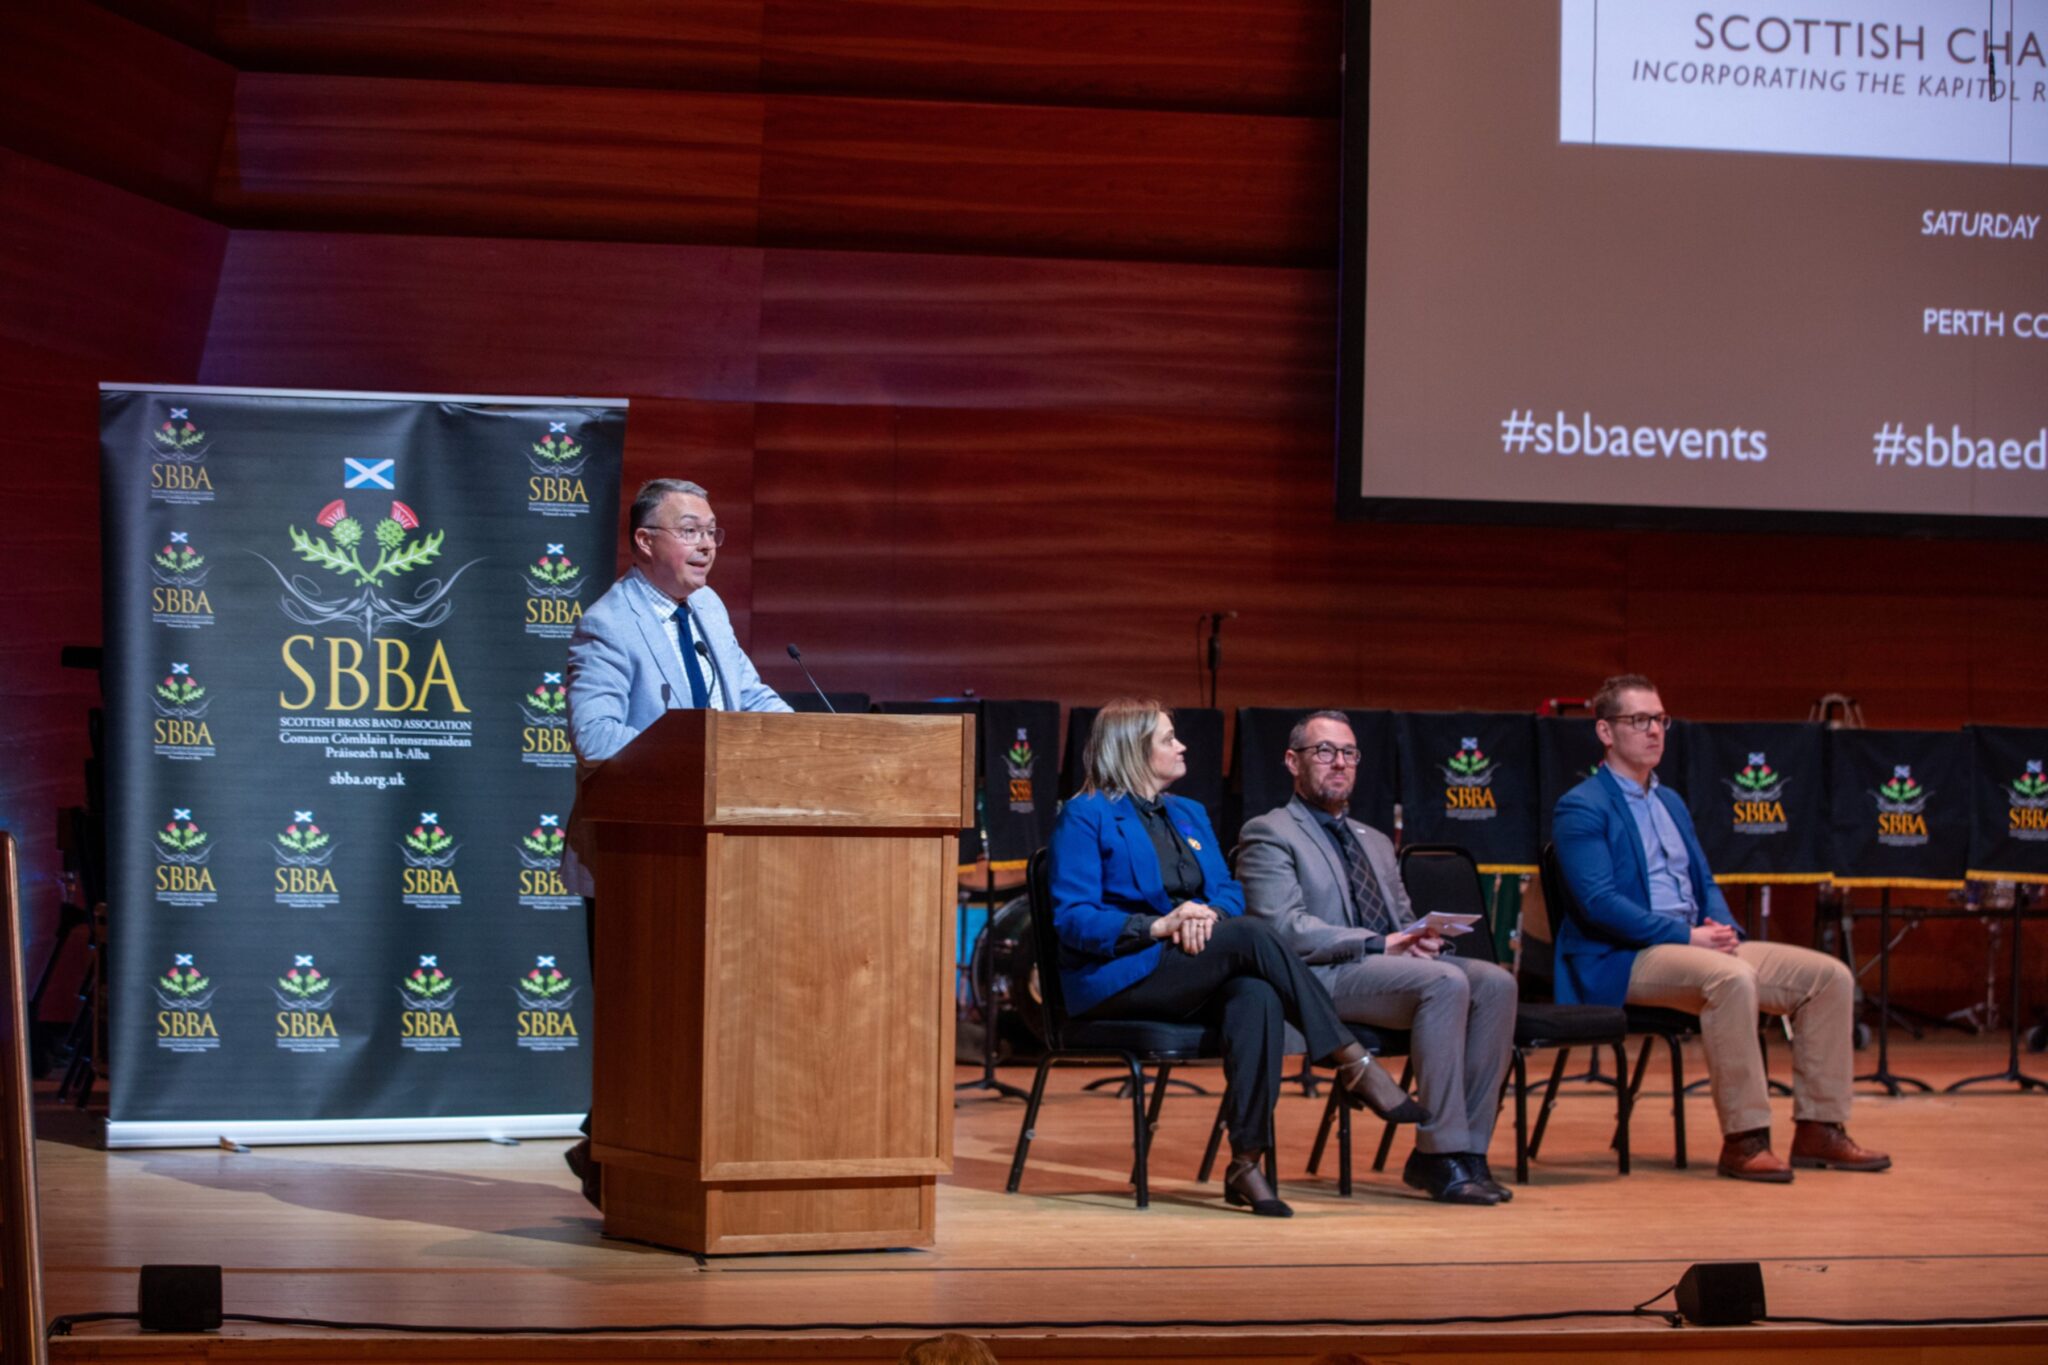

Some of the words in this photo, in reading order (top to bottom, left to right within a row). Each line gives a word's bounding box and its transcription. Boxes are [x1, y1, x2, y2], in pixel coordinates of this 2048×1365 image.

[1694, 13, 1925, 61] SCOTTISH
[1632, 60, 1847, 92] INCORPORATING
[1856, 71, 1906, 95] THE
[1918, 75, 2020, 101] KAPITOL
[1921, 209, 2041, 239] SATURDAY
[1923, 307, 2004, 337] PERTH
[1501, 409, 1768, 461] #sbbaevents
[1873, 422, 2048, 470] #sbbaed
[151, 463, 214, 490] SBBA
[528, 477, 590, 503] SBBA
[152, 588, 214, 614] SBBA
[525, 598, 583, 624] SBBA
[278, 634, 471, 713] SBBA
[154, 719, 213, 746] SBBA
[280, 717, 335, 728] SCOTTISH
[337, 718, 370, 728] BRASS
[372, 718, 402, 729] BAND
[403, 720, 472, 731] ASSOCIATION
[279, 732, 329, 744] Comann
[389, 734, 472, 747] Ionnsramaidean
[380, 750, 394, 759] na
[395, 748, 430, 760] h-Alba
[329, 772, 406, 789] sbba.org.uk
[1445, 786, 1497, 809] SBBA
[1733, 801, 1786, 824] SBBA
[1878, 813, 1928, 836] SBBA
[156, 865, 216, 892] SBBA
[275, 867, 338, 893] SBBA
[402, 868, 460, 895] SBBA
[518, 869, 568, 896] SBB
[157, 1011, 219, 1037] SBBA
[276, 1011, 339, 1037] SBBA
[402, 1011, 460, 1037] SBBA
[517, 1011, 578, 1037] SBBA
